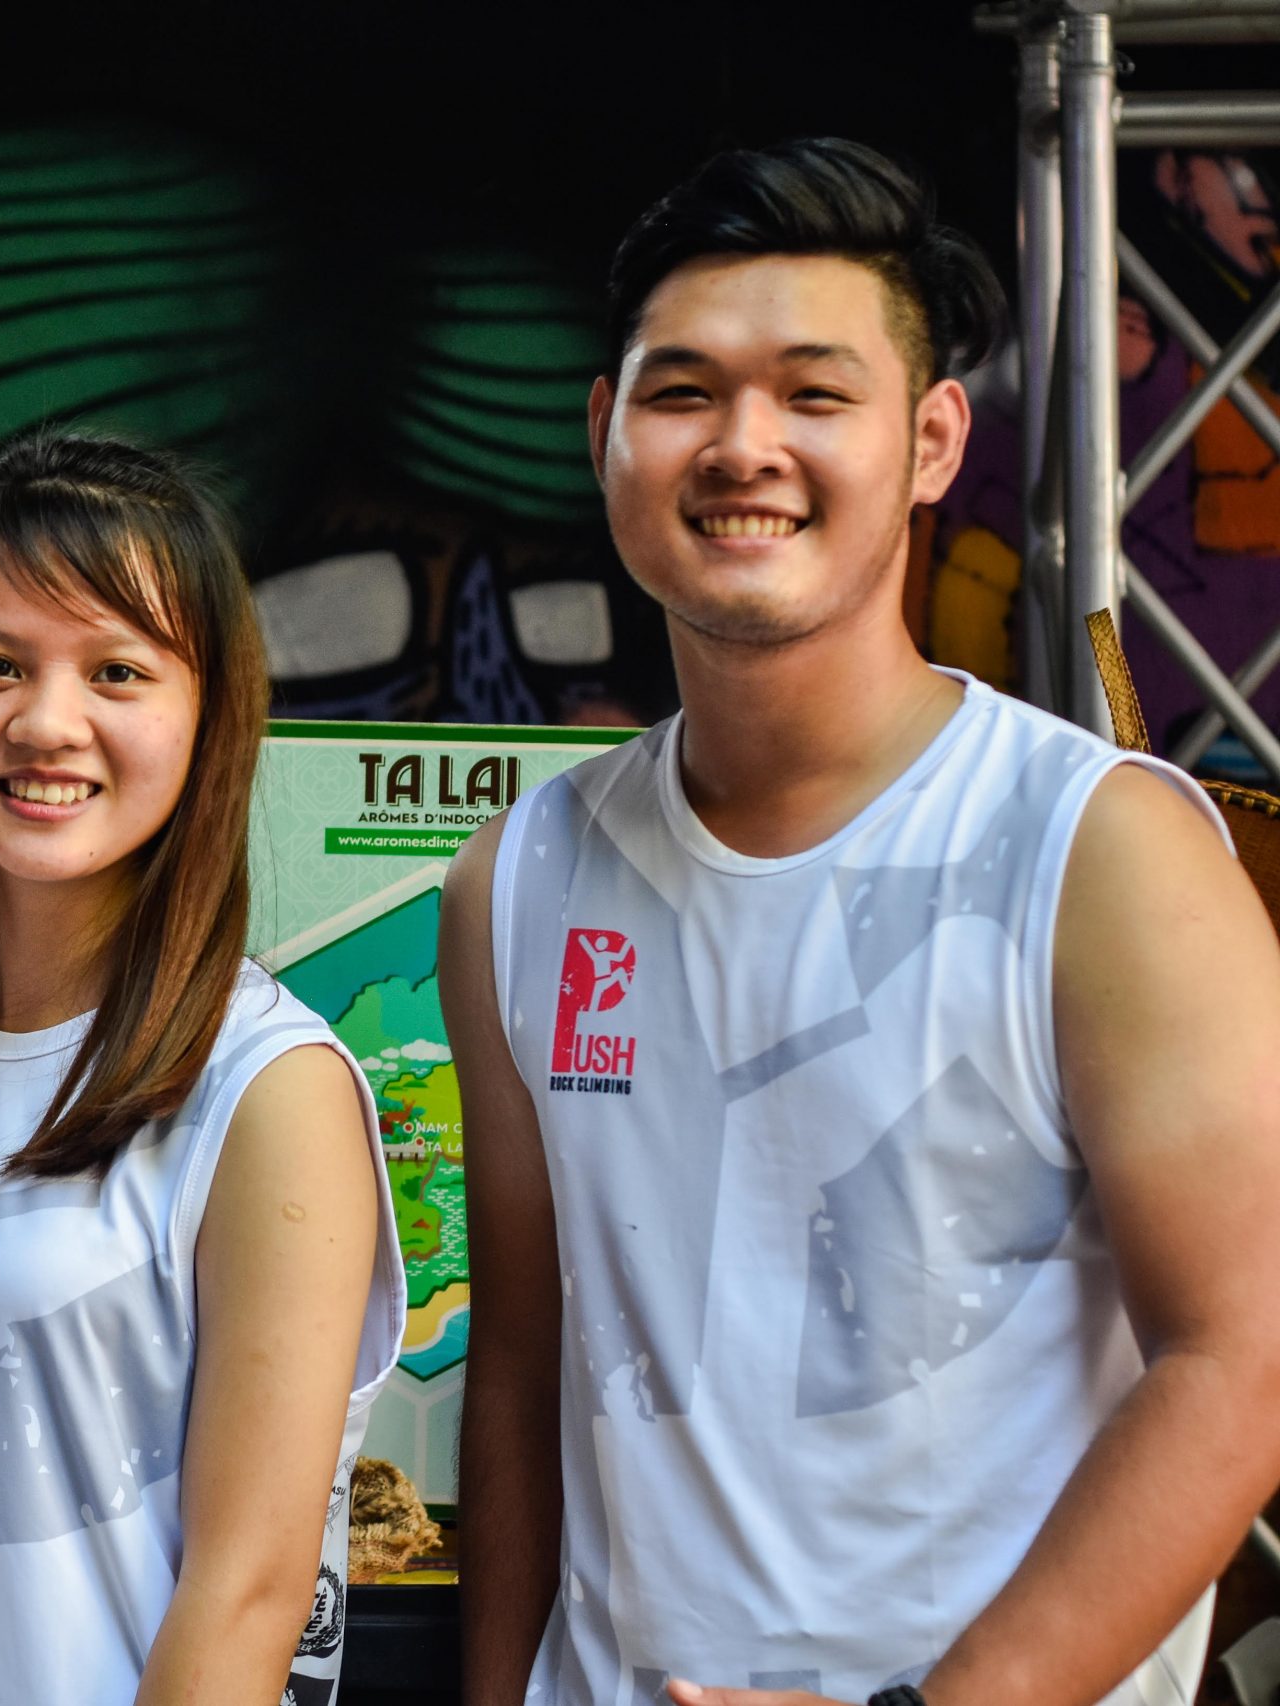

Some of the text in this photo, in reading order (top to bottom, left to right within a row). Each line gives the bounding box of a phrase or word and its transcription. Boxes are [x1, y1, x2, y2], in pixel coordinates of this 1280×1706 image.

[359, 753, 521, 809] TA LAI
[358, 810, 418, 823] ARÔMES
[551, 928, 637, 1076] PUSH
[550, 1076, 632, 1095] ROCK CLIMBING
[416, 1121, 448, 1133] NAM
[426, 1142, 443, 1152] TA
